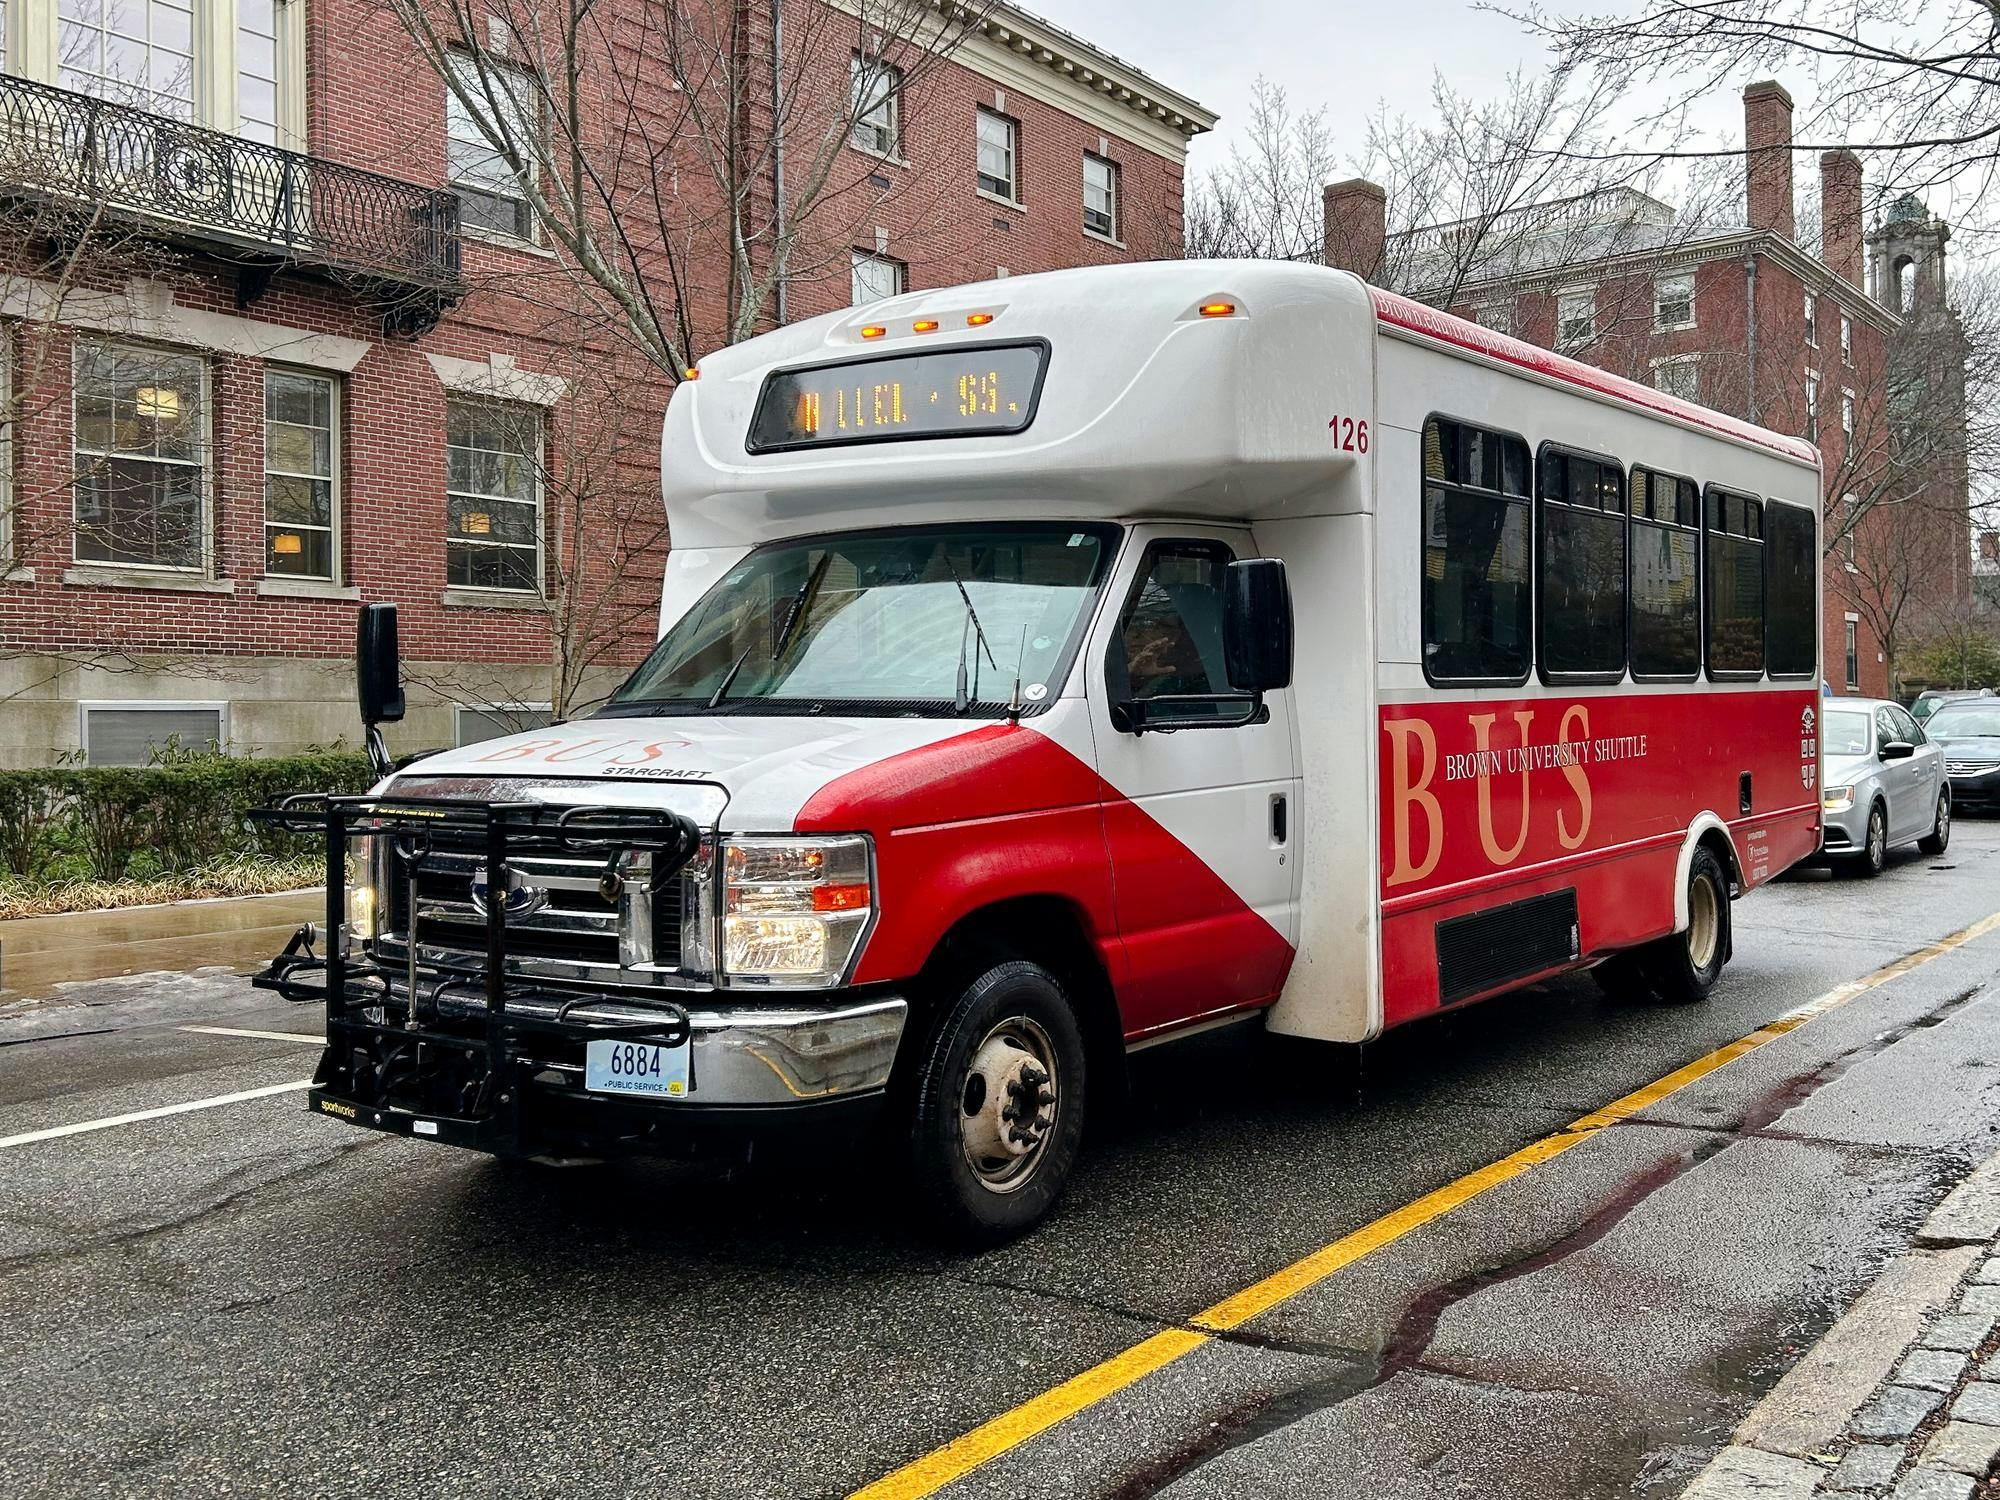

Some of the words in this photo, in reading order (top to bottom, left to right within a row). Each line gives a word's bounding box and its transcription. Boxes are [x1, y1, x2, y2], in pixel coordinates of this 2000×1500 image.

[1328, 414, 1369, 454] 126
[468, 739, 693, 764] BUS
[1445, 749, 1502, 781] BROWN
[1506, 740, 1591, 774] UNIVERSITY
[1594, 734, 1648, 763] SHUTTLE
[601, 766, 713, 779] STARCRAFT
[1383, 703, 1592, 887] BUS
[611, 1044, 661, 1078] 6884
[608, 1080, 633, 1089] PUBLIC
[634, 1082, 664, 1092] SERVICE
